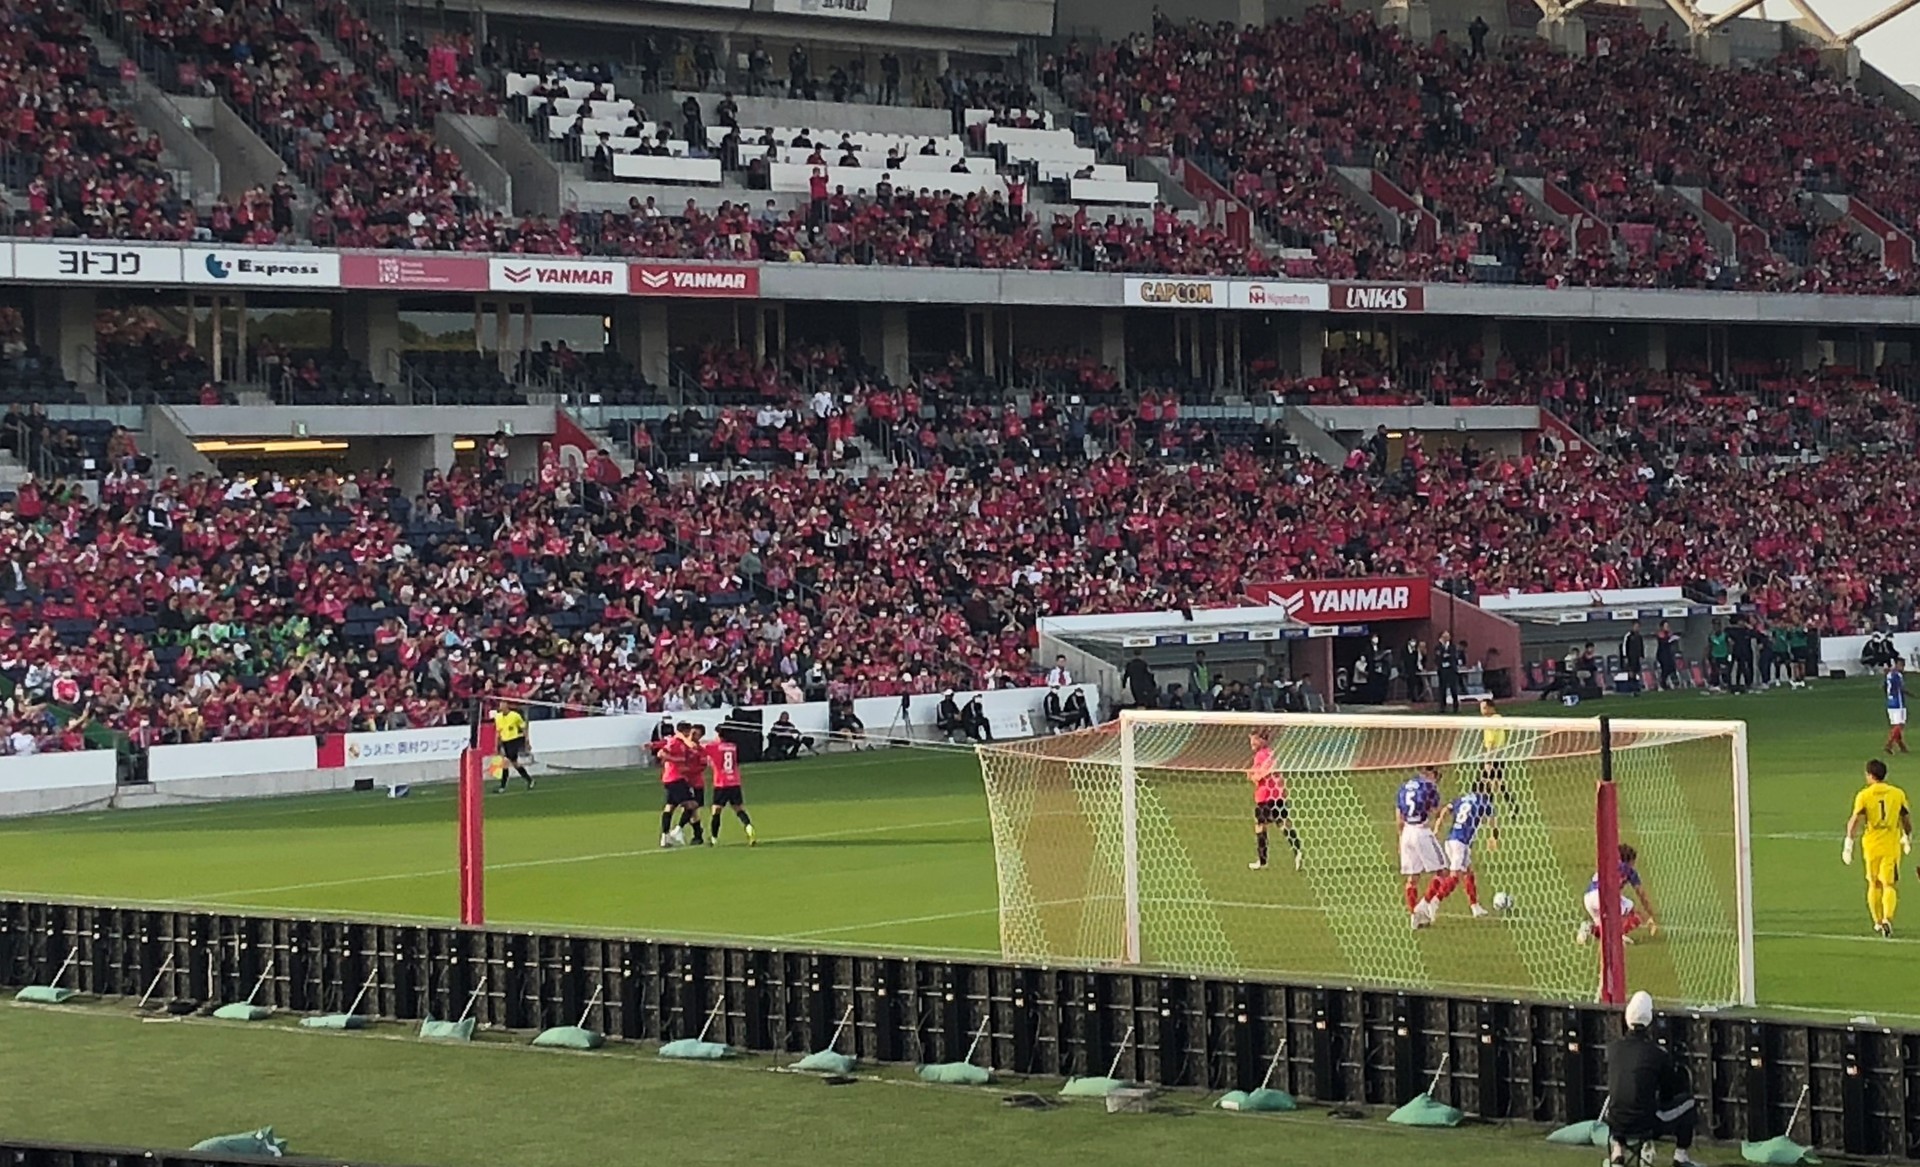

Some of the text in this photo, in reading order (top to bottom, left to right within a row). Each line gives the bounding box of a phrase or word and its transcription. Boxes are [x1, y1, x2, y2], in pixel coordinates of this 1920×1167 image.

[238, 259, 319, 276] Express
[536, 268, 613, 285] YANMAR
[672, 272, 746, 289] YANMAR
[1141, 282, 1213, 303] CAPCOM
[1309, 586, 1410, 613] YANMAR
[723, 751, 734, 770] 8
[1405, 790, 1416, 816] 5
[1456, 802, 1472, 824] 8
[1878, 800, 1886, 820] 1
